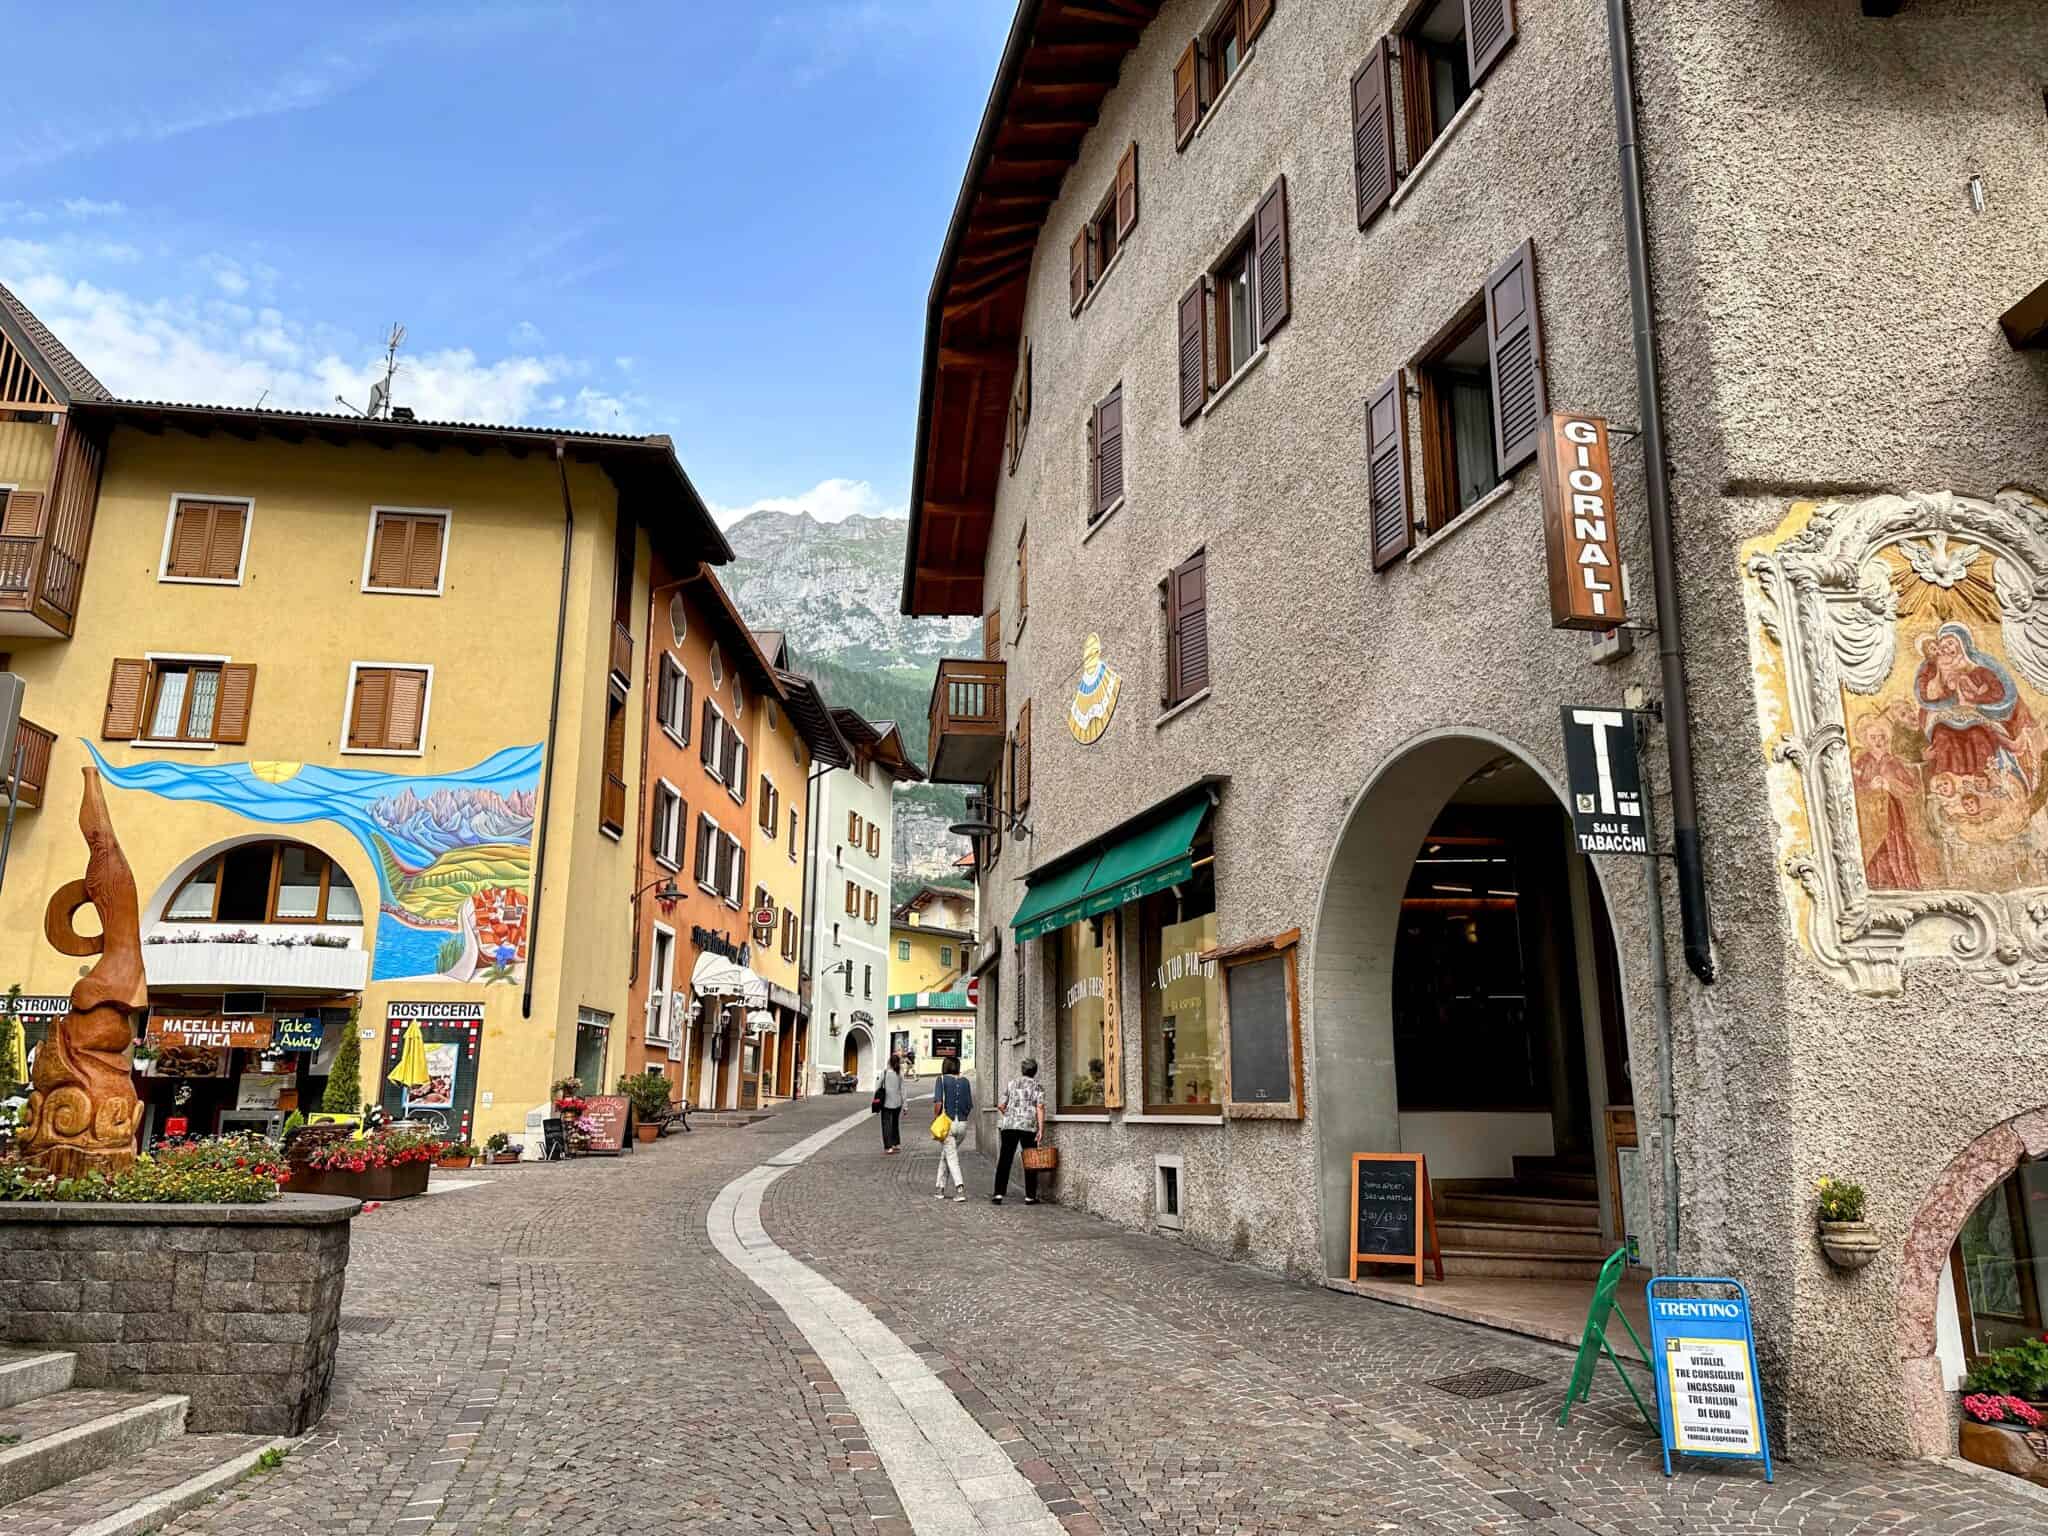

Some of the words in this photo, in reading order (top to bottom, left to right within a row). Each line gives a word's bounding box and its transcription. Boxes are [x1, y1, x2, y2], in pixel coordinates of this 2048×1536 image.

[1564, 421, 1611, 615] GIORNALI
[1572, 710, 1624, 815] T
[1592, 822, 1618, 833] SALI
[1621, 823, 1629, 834] E
[1579, 834, 1646, 852] TABACCHI
[1158, 966, 1168, 990] IL
[1167, 955, 1182, 982] TUO
[1067, 978, 1088, 1008] CUCINA
[391, 1004, 481, 1017] ROSTICCERIA
[1105, 924, 1115, 1097] GASTRONOMIA
[163, 1019, 255, 1033] MACELLERIA
[278, 1018, 312, 1033] Take
[184, 1033, 231, 1046] TIPICA
[280, 1034, 322, 1049] Away
[1657, 1302, 1740, 1317] TRENTINO
[1675, 1368, 1691, 1378] TRE
[1692, 1369, 1744, 1381] CONSIGLIERI
[1687, 1382, 1735, 1393] INCASSANO
[1688, 1395, 1704, 1405] TRE
[1705, 1396, 1738, 1407] MILIONI
[1698, 1408, 1707, 1418] DI
[1709, 1409, 1731, 1419] EURO
[1687, 1434, 1711, 1442] FAMIGLIA
